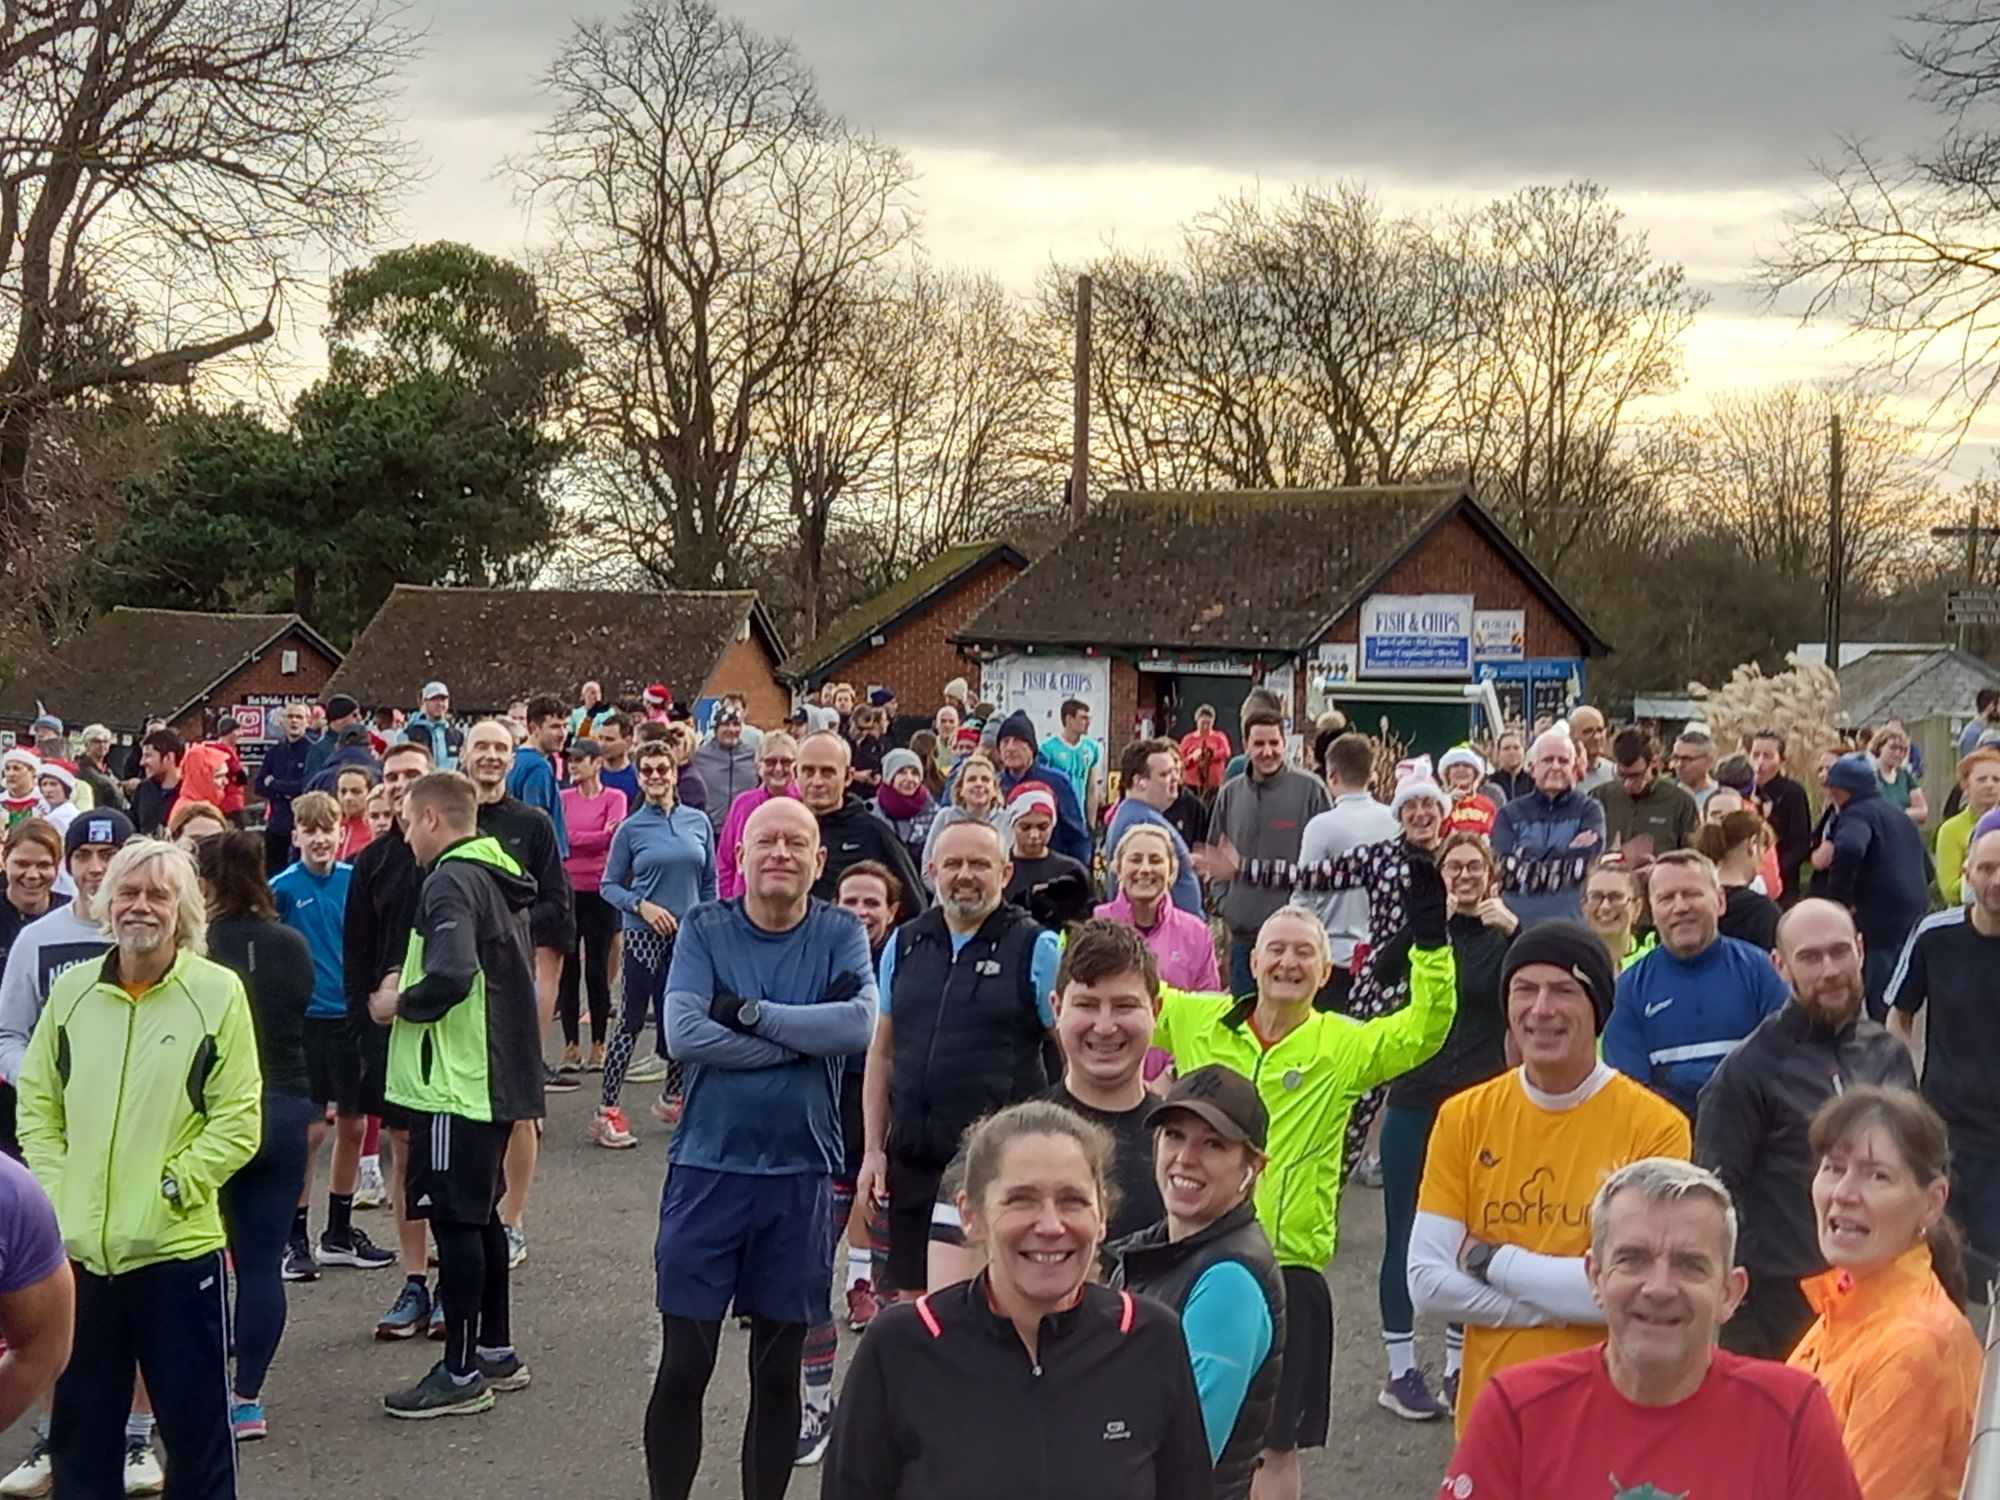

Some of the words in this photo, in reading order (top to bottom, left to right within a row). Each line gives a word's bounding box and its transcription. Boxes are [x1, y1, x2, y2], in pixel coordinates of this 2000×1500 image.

[1376, 612, 1405, 633] FISH
[1409, 612, 1419, 633] &
[1422, 612, 1460, 633] CHIPS
[1023, 671, 1047, 689] FISH
[1049, 672, 1058, 690] &
[1060, 673, 1093, 693] CHIPS
